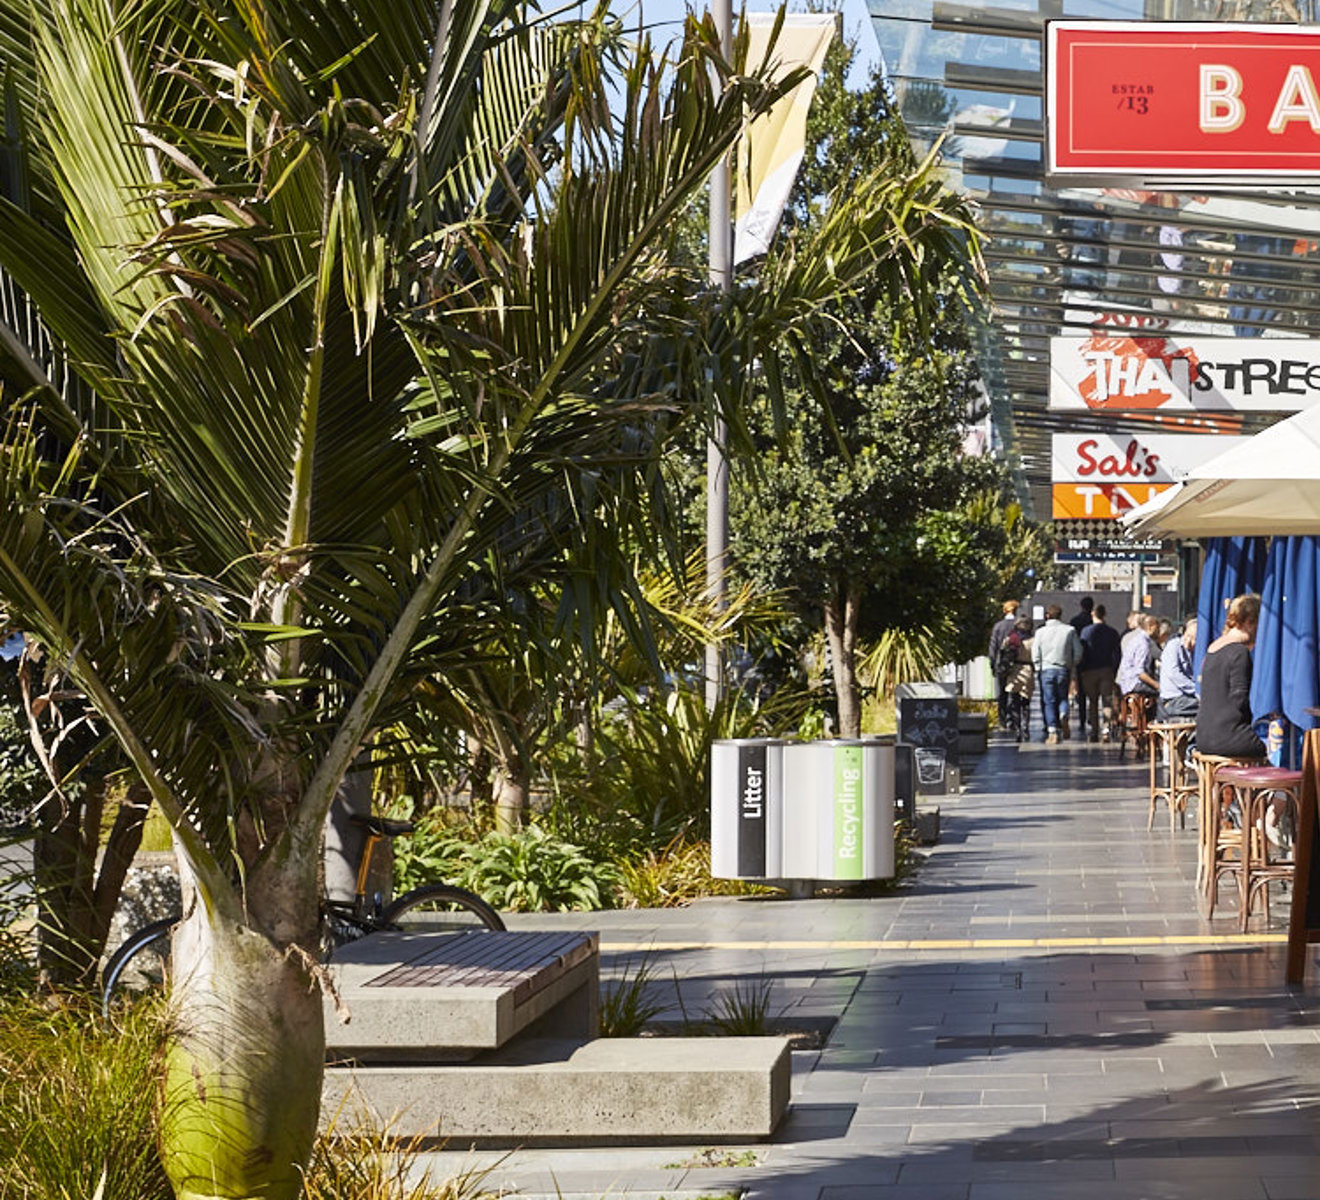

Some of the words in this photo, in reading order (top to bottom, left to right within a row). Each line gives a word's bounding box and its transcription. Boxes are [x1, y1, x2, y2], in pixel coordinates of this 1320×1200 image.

[1112, 84, 1154, 95] ESTAB
[1084, 350, 1192, 402] THAI
[1077, 439, 1160, 476] Sal's
[743, 766, 763, 819] Litter
[839, 769, 860, 859] Recycling
